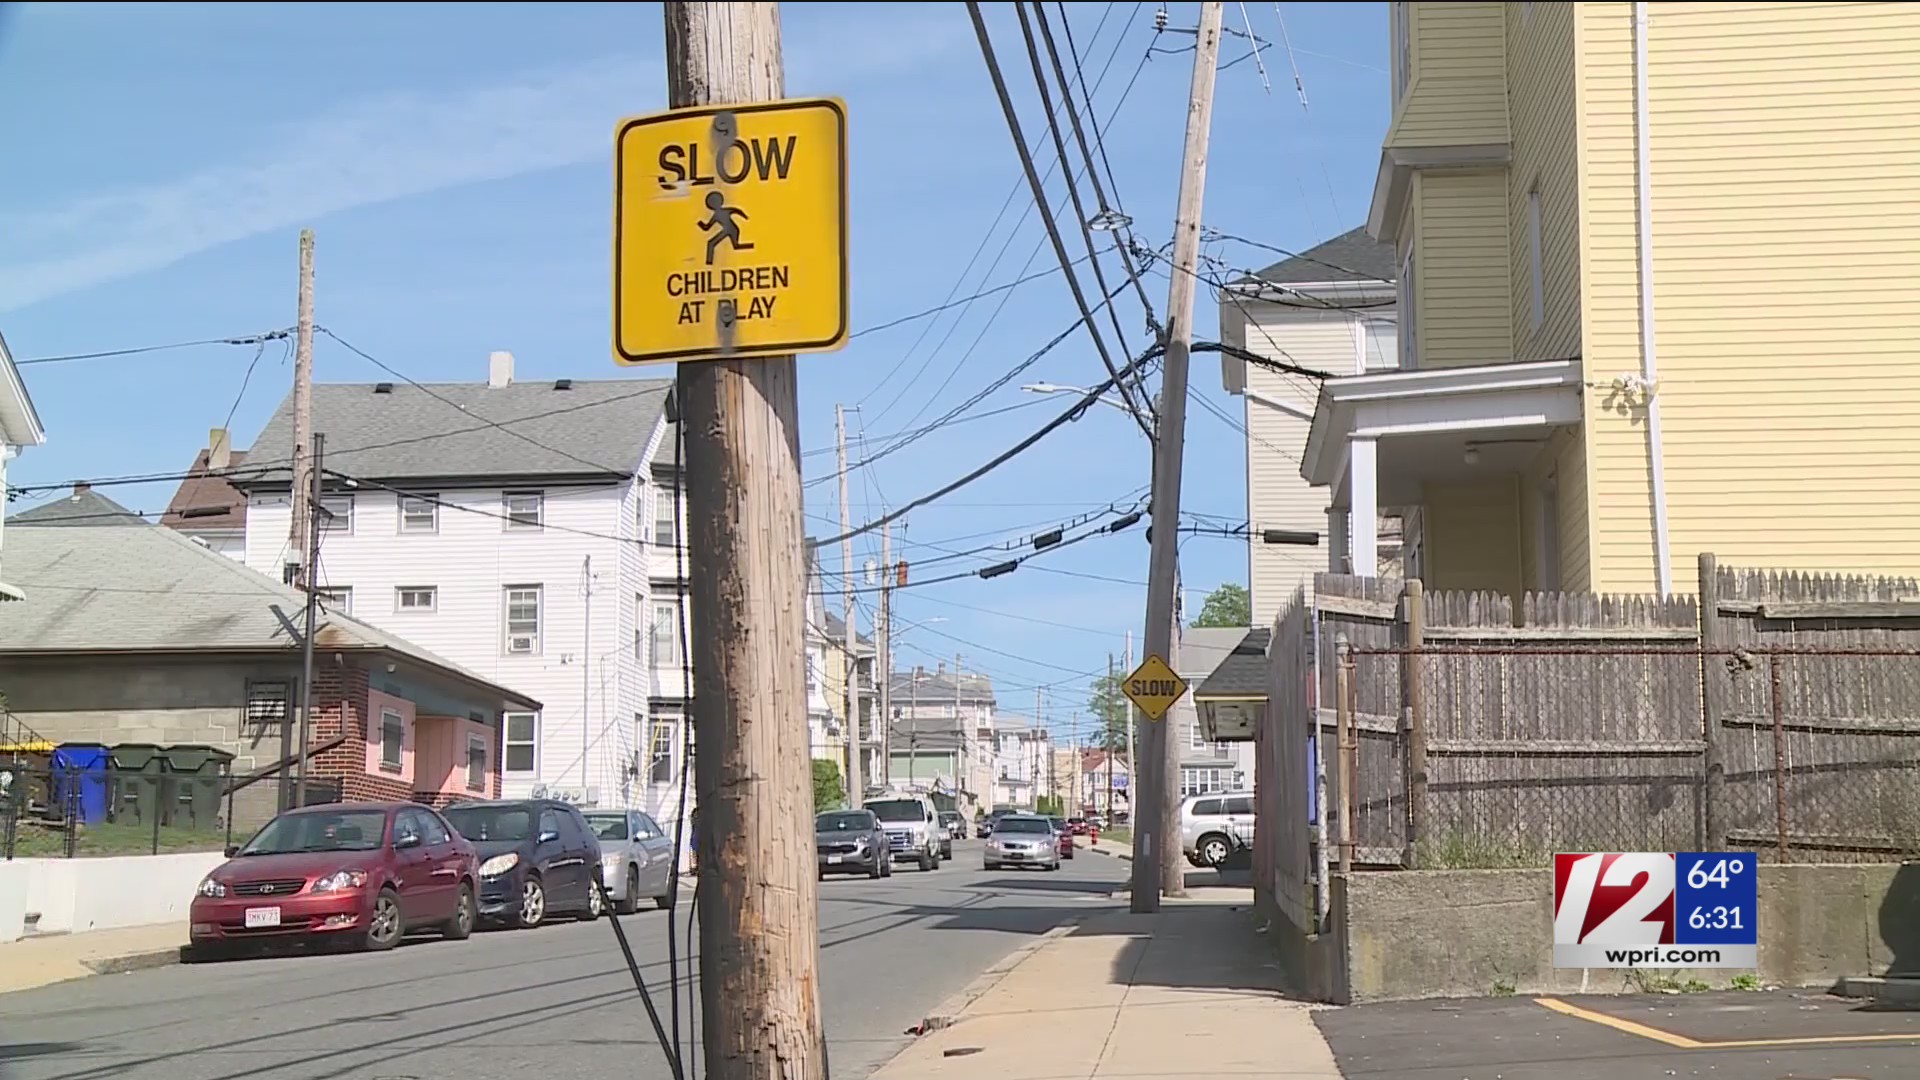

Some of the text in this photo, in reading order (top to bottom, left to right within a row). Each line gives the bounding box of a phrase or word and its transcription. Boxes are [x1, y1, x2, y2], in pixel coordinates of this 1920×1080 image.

[658, 135, 797, 190] SLOW
[666, 265, 789, 297] CHILDREN
[677, 300, 706, 325] AT
[1131, 679, 1176, 696] SLOW
